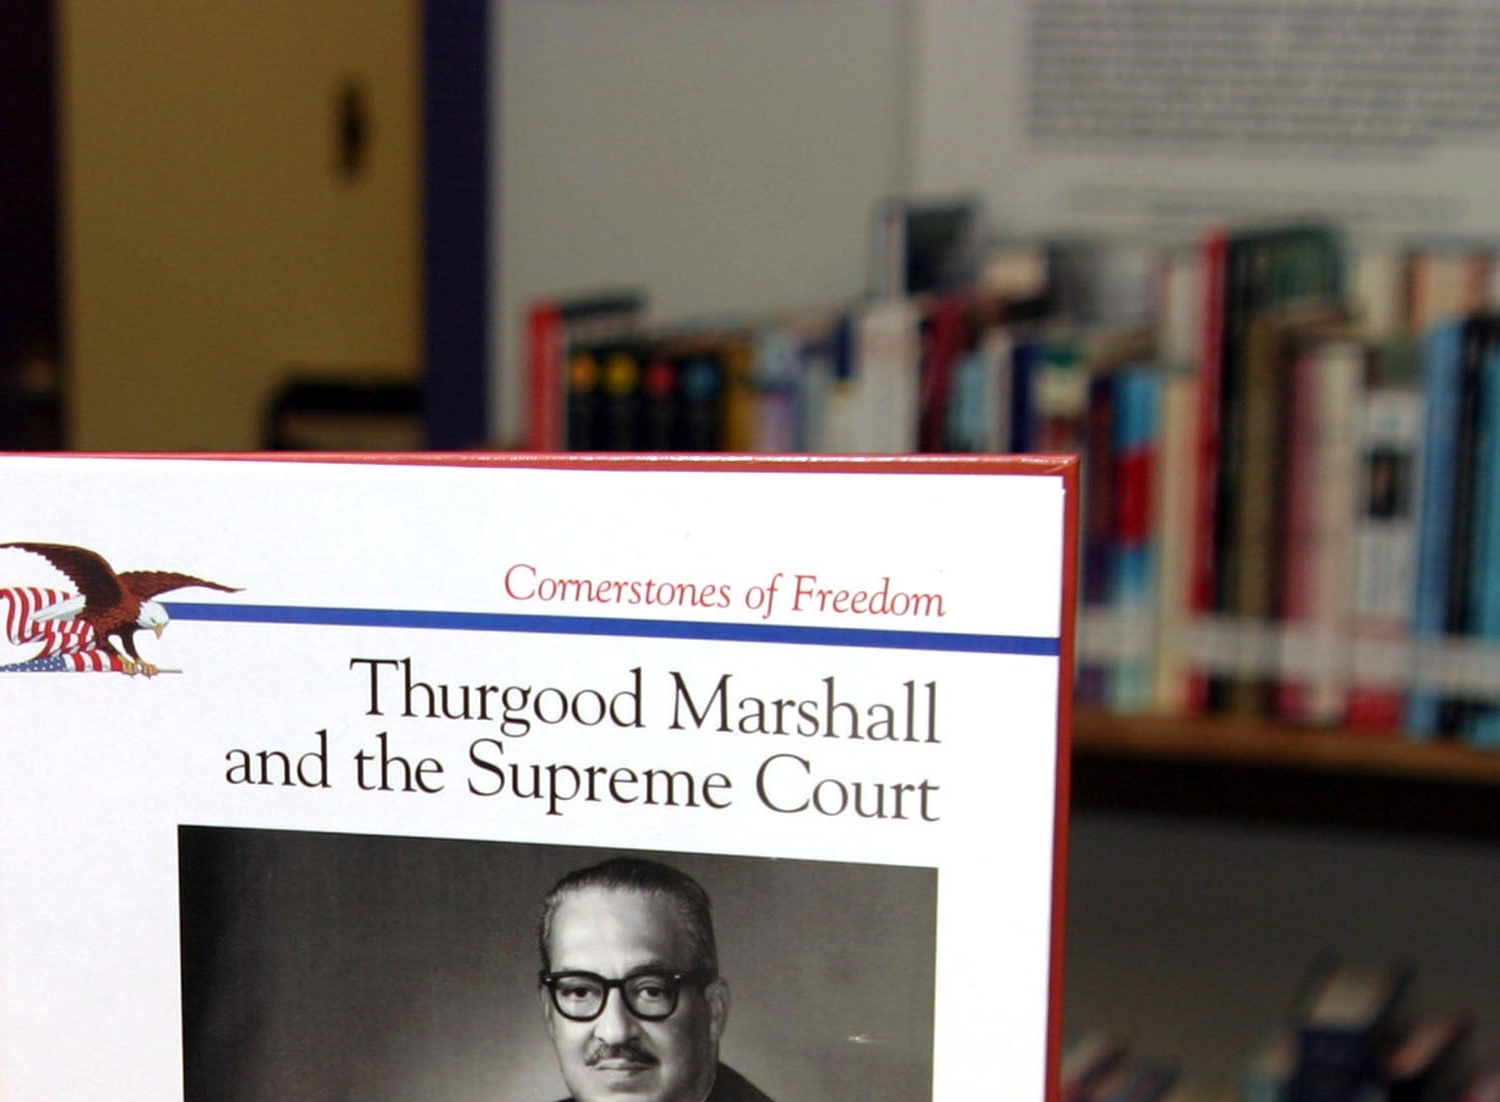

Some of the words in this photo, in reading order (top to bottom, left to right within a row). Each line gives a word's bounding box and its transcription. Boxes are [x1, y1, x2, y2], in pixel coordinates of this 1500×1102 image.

[503, 563, 731, 610] Cornerstones
[741, 573, 785, 618] of
[791, 575, 946, 617] Freedom
[350, 658, 646, 737] Thurgood
[668, 671, 942, 744] Marshall
[224, 729, 330, 790] and
[353, 735, 444, 794] the
[467, 742, 733, 816] Supreme
[756, 754, 941, 822] Court
